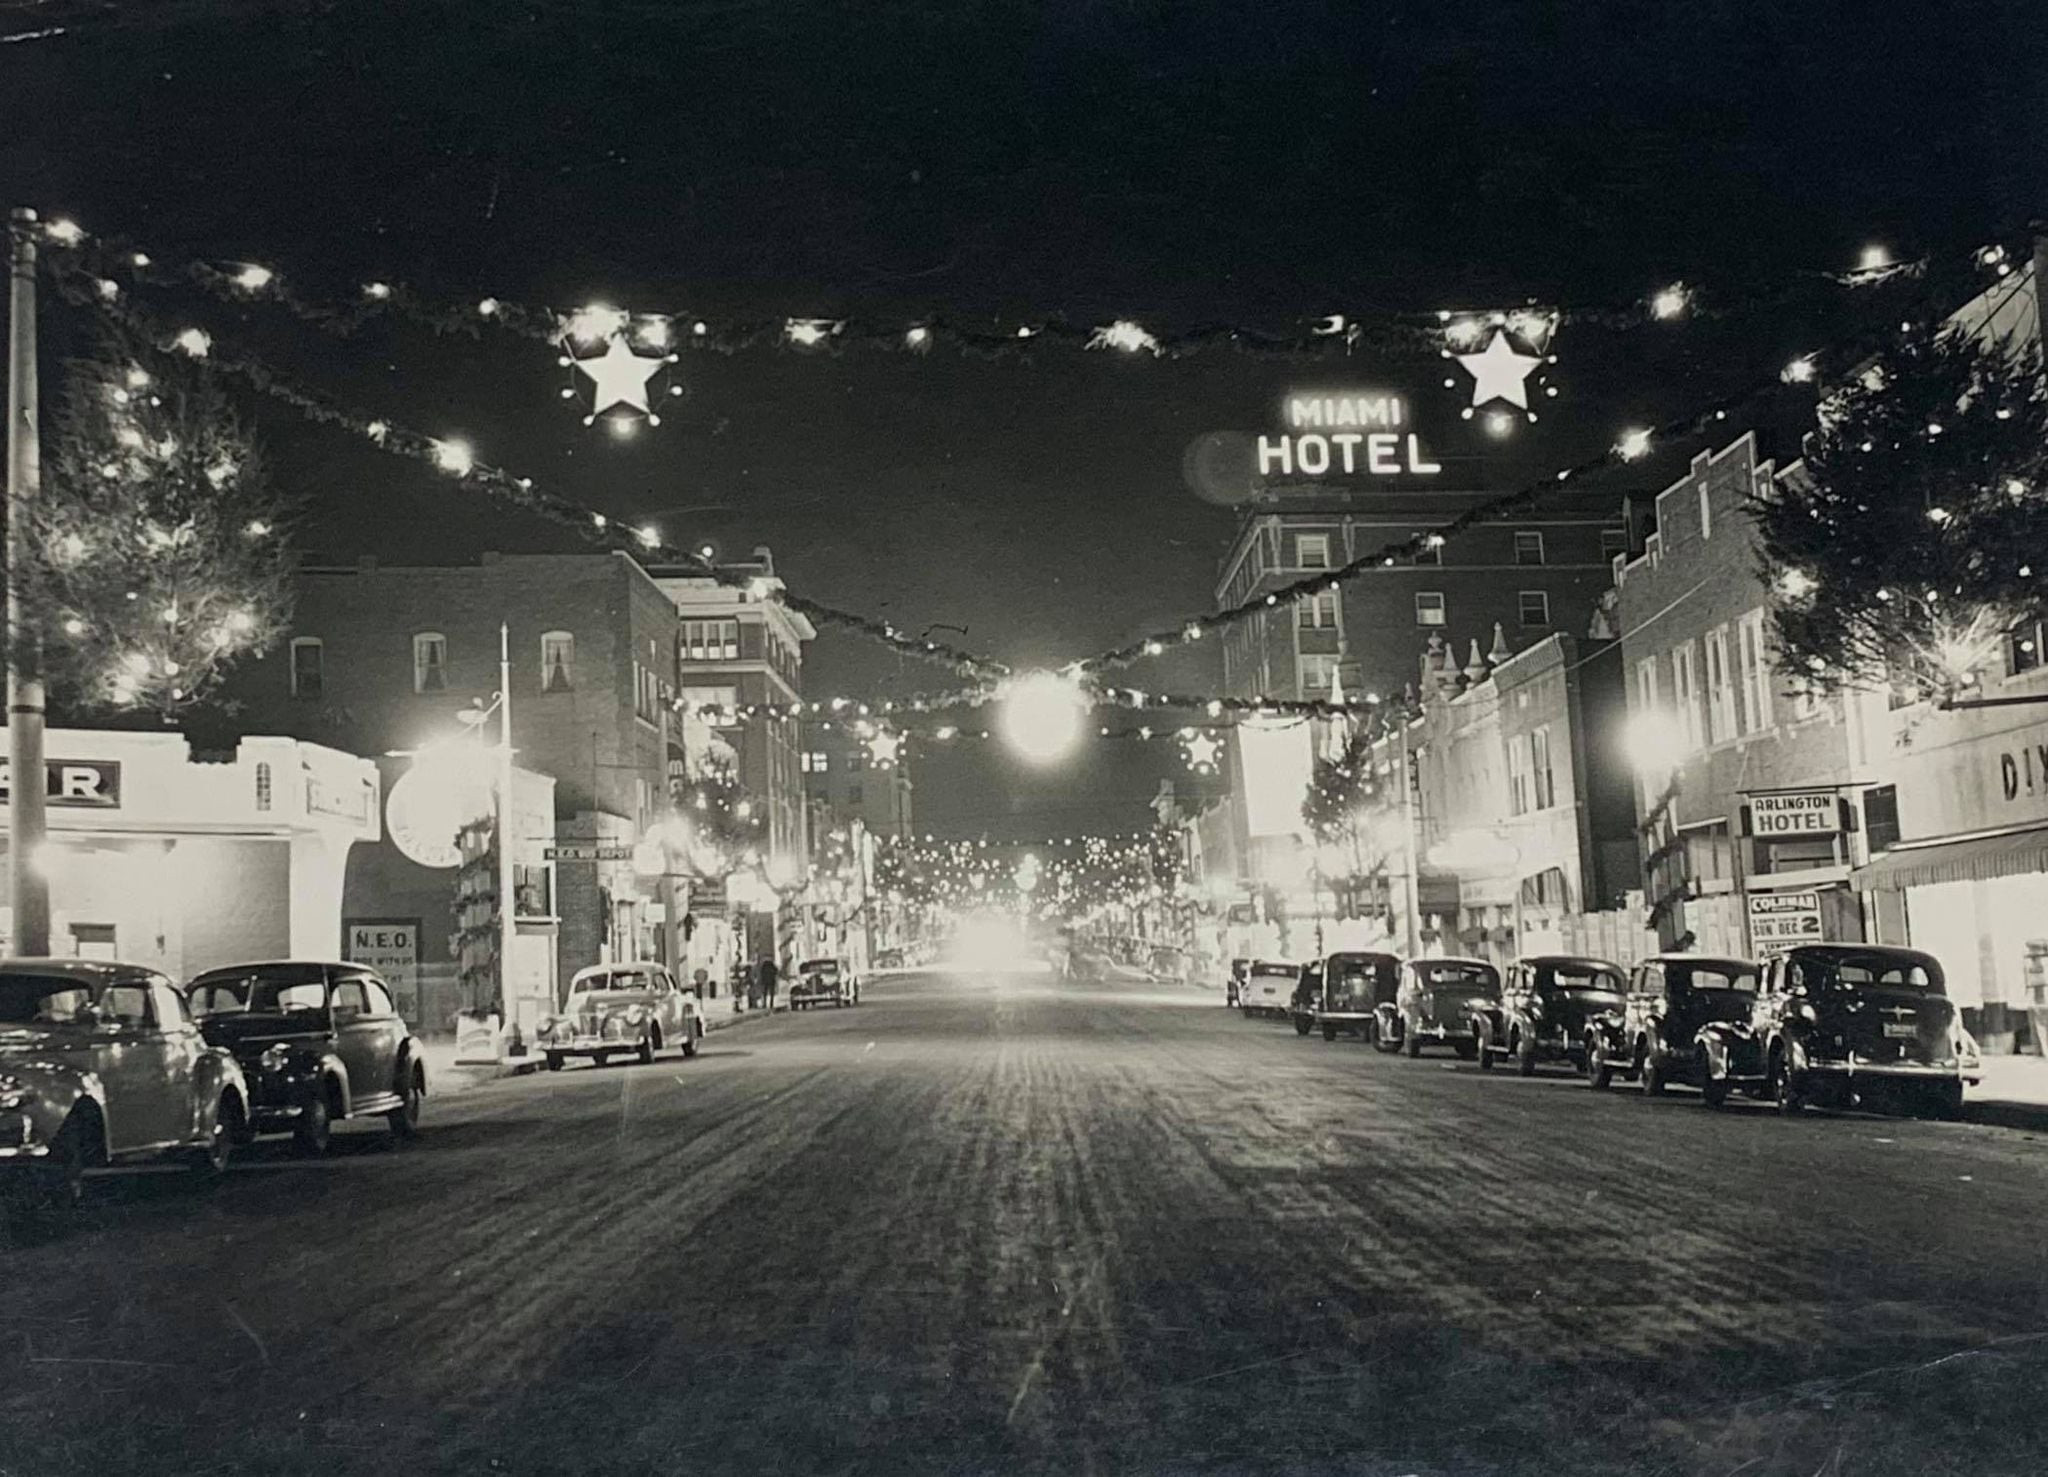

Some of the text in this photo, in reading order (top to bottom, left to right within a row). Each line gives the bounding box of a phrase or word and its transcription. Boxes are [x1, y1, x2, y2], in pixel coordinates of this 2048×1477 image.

[1291, 398, 1401, 427] MIAMI
[1258, 433, 1442, 475] HOTEL
[1755, 796, 1831, 811] ARLINGTON
[1758, 813, 1832, 832] HOTEL
[1801, 916, 1820, 934] 2
[356, 930, 413, 949] N.E.O.
